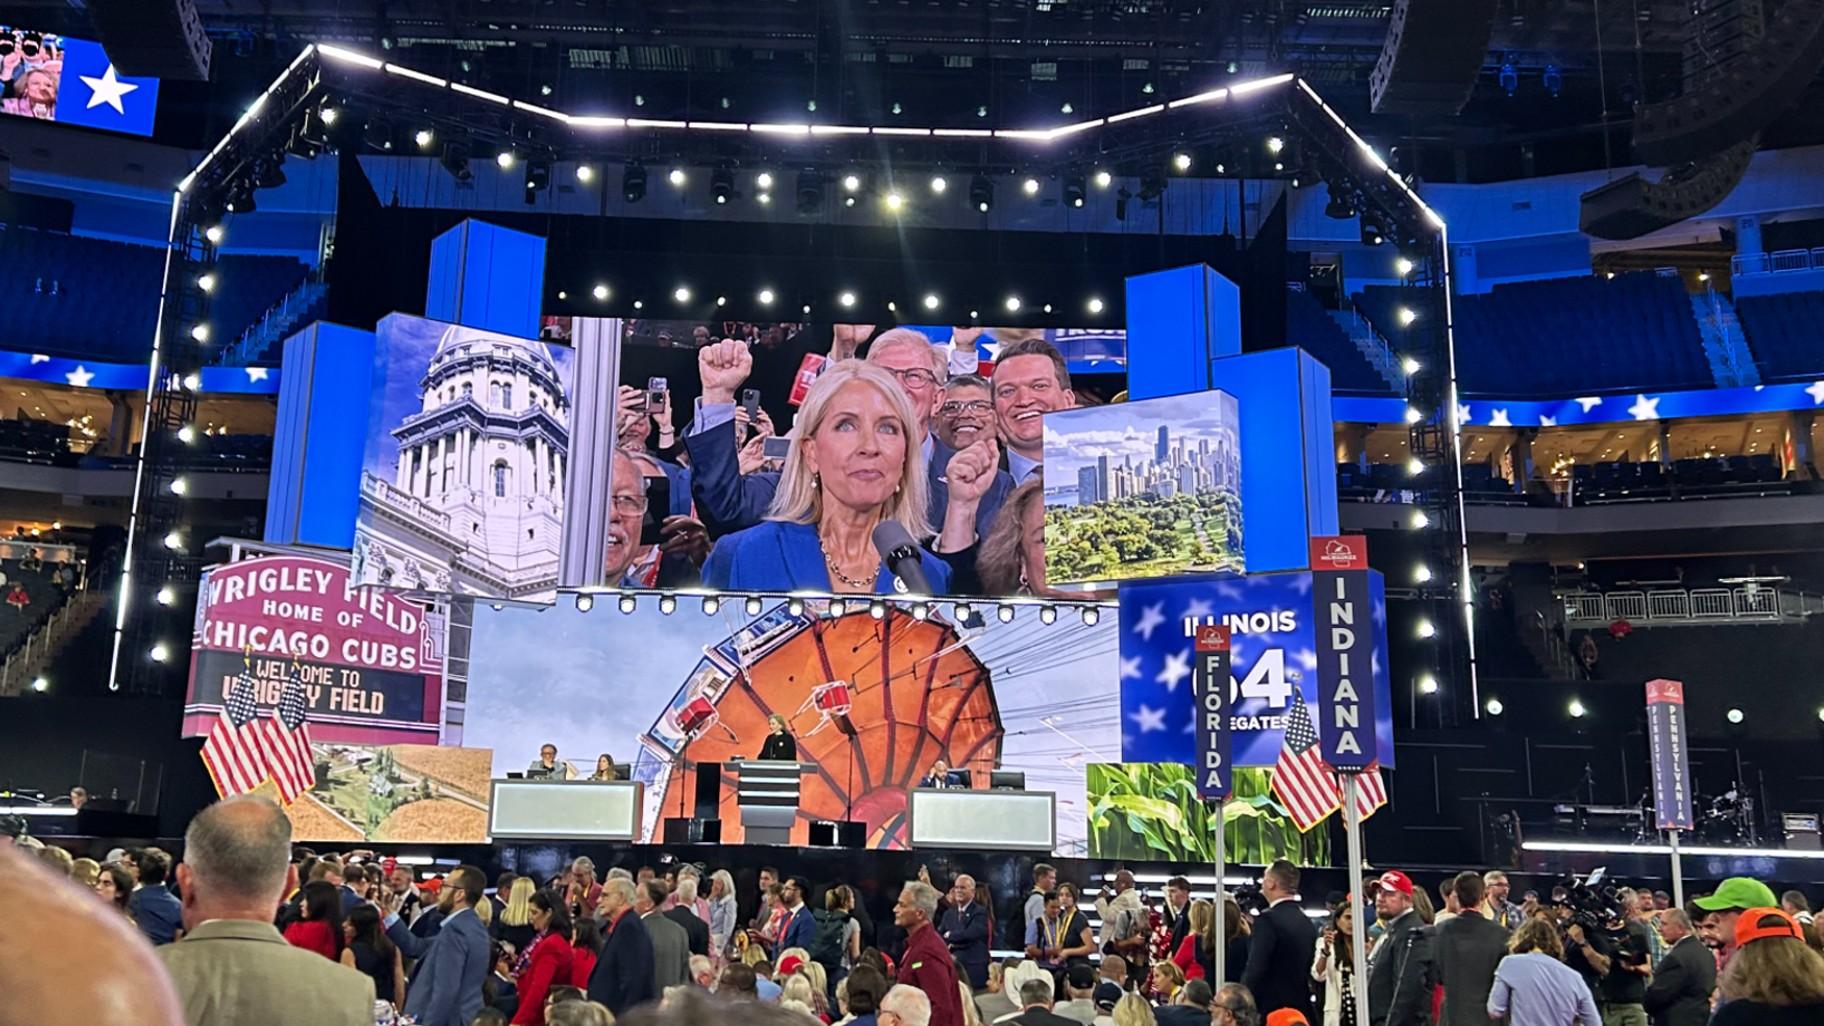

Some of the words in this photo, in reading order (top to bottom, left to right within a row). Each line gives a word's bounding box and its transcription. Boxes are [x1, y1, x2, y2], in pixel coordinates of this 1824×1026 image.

[208, 567, 332, 607] WRIGLEY
[344, 577, 417, 635] FIELD
[262, 599, 324, 622] HOME
[337, 611, 364, 628] OF
[203, 619, 330, 658] CHICAGO
[342, 638, 416, 669] CUBS
[257, 659, 333, 685] WELOME
[340, 669, 360, 688] TO
[1330, 577, 1361, 754] INDIANA
[329, 687, 384, 715] FIELD
[1205, 656, 1222, 788] FLORIDA
[1669, 704, 1686, 821] PENNSYLVANIA
